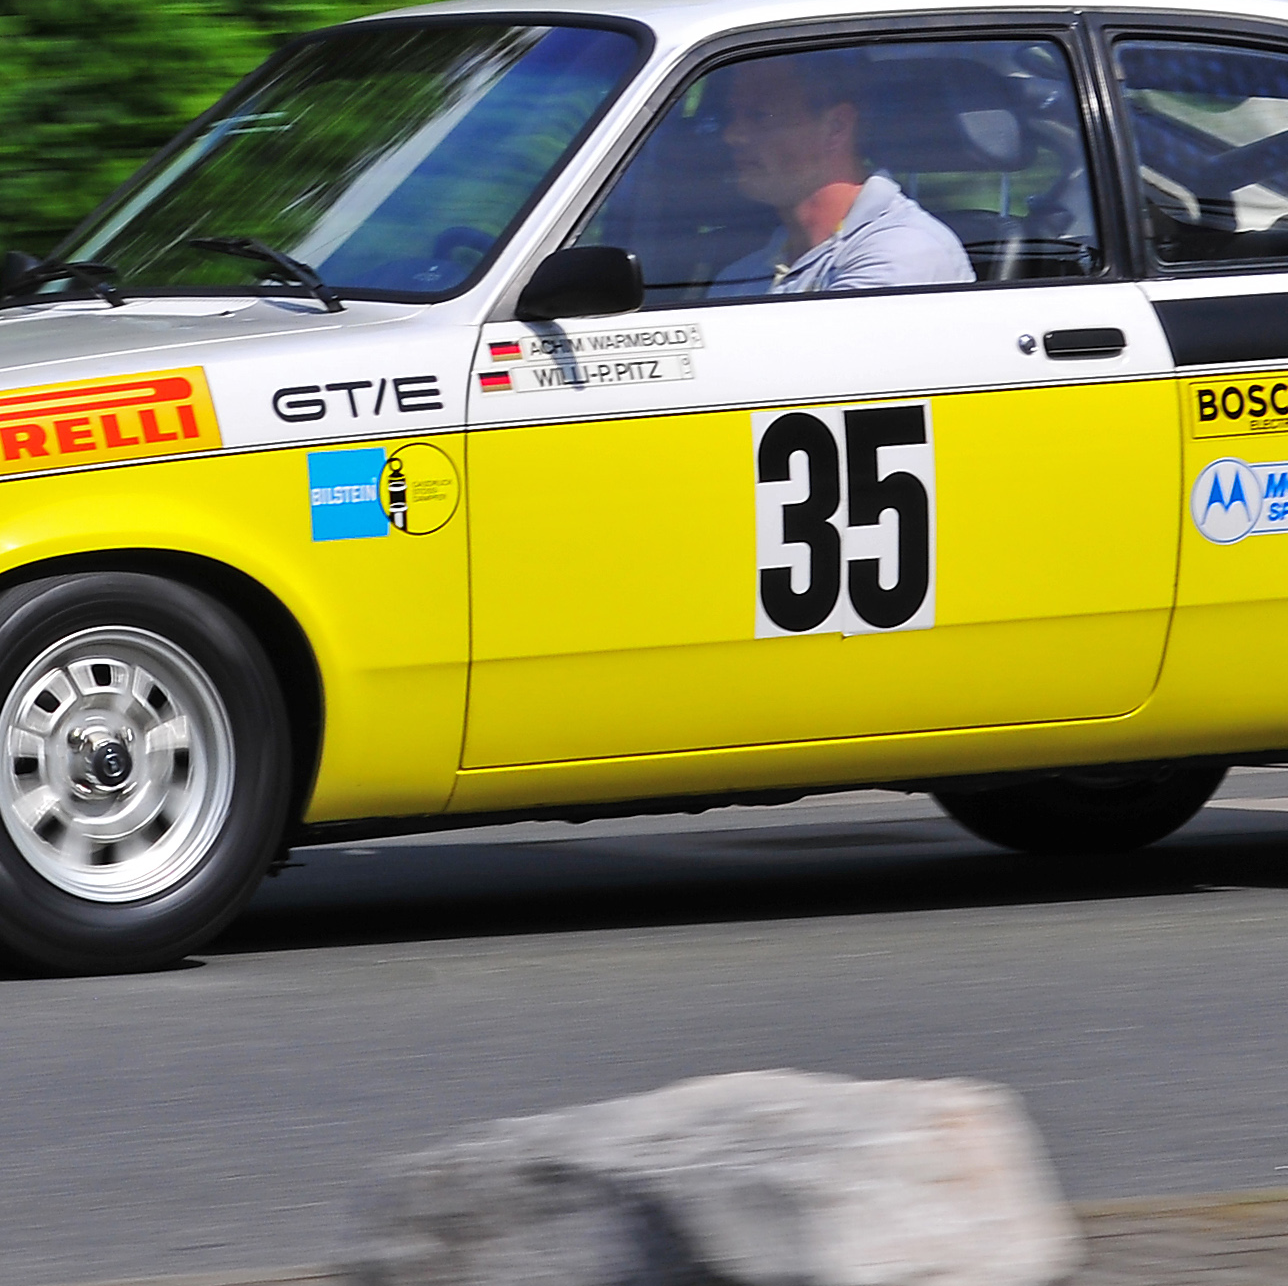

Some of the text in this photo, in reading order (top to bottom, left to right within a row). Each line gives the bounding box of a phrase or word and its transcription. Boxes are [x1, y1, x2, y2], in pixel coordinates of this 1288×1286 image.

[530, 337, 585, 356] ACHIM
[587, 329, 688, 351] WARMBOLD
[272, 375, 444, 423] GT/E
[311, 484, 378, 507] BILSTEIN
[757, 405, 929, 632] 35
